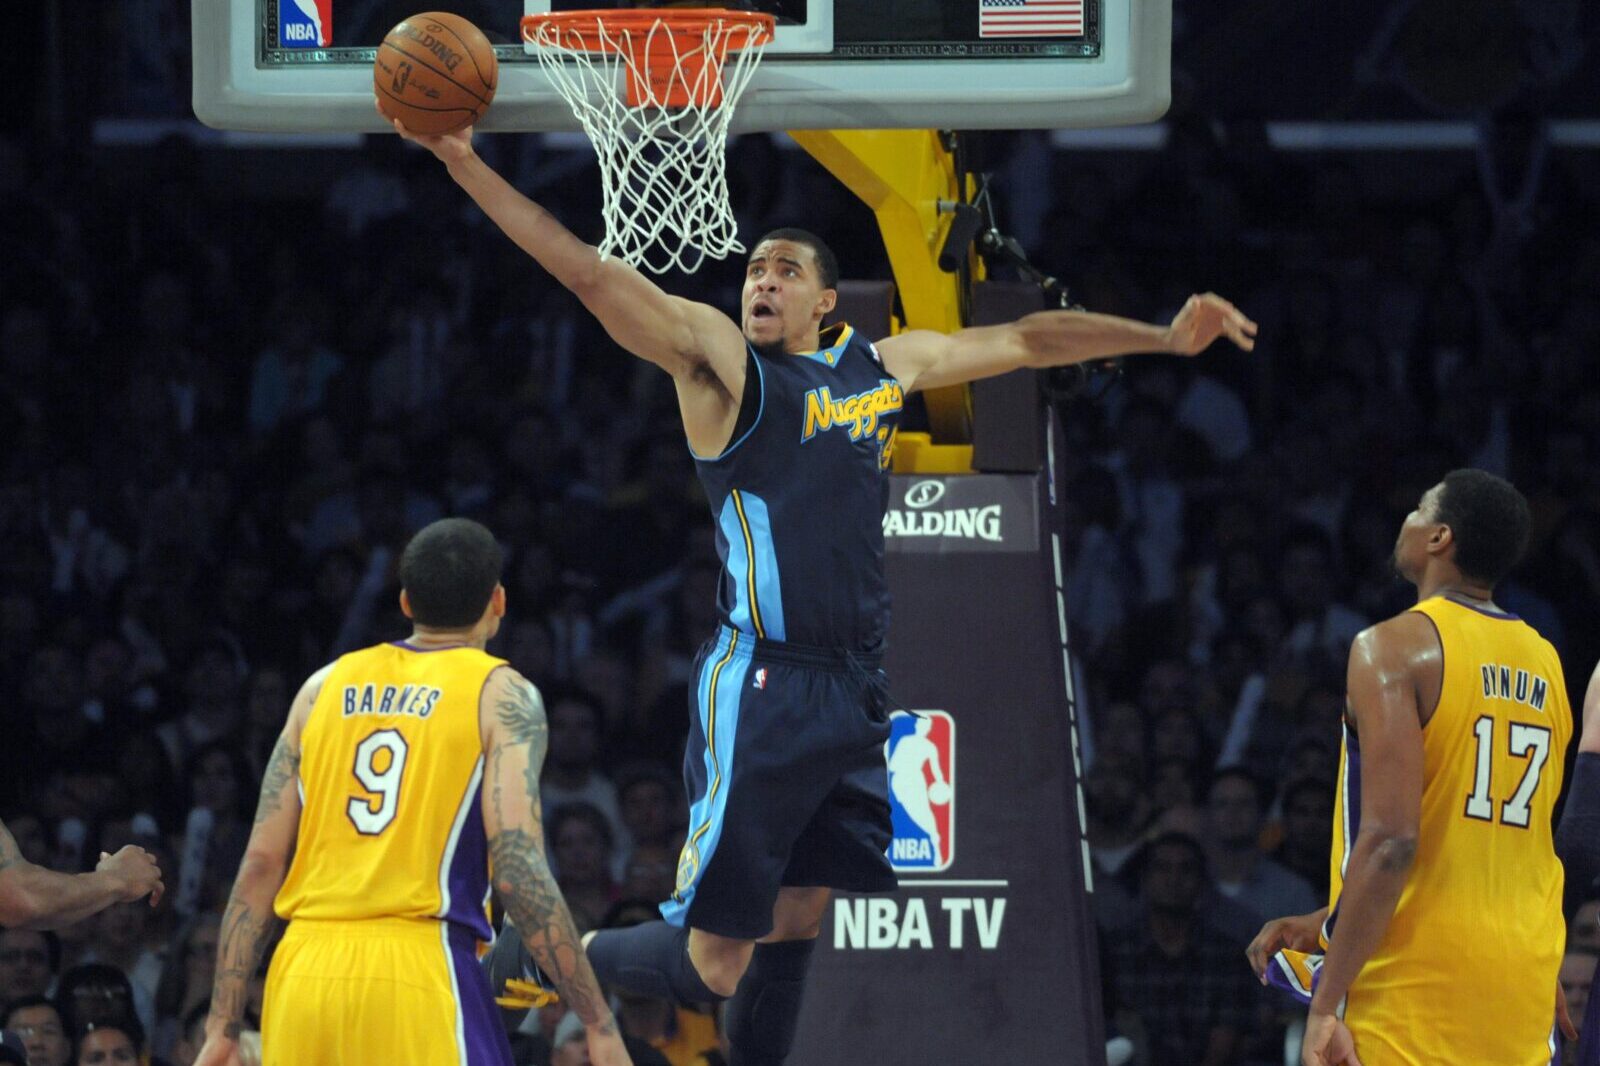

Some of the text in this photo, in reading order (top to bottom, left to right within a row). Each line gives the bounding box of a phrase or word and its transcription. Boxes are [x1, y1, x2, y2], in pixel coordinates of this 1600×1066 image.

[285, 23, 315, 40] NBA
[801, 379, 903, 443] Nuggets
[344, 684, 441, 718] BARNES
[1480, 664, 1547, 711] BYNUM
[346, 728, 409, 836] 9
[1464, 714, 1552, 829] 17
[892, 838, 931, 860] NBA
[834, 898, 1007, 949] NBA TV
